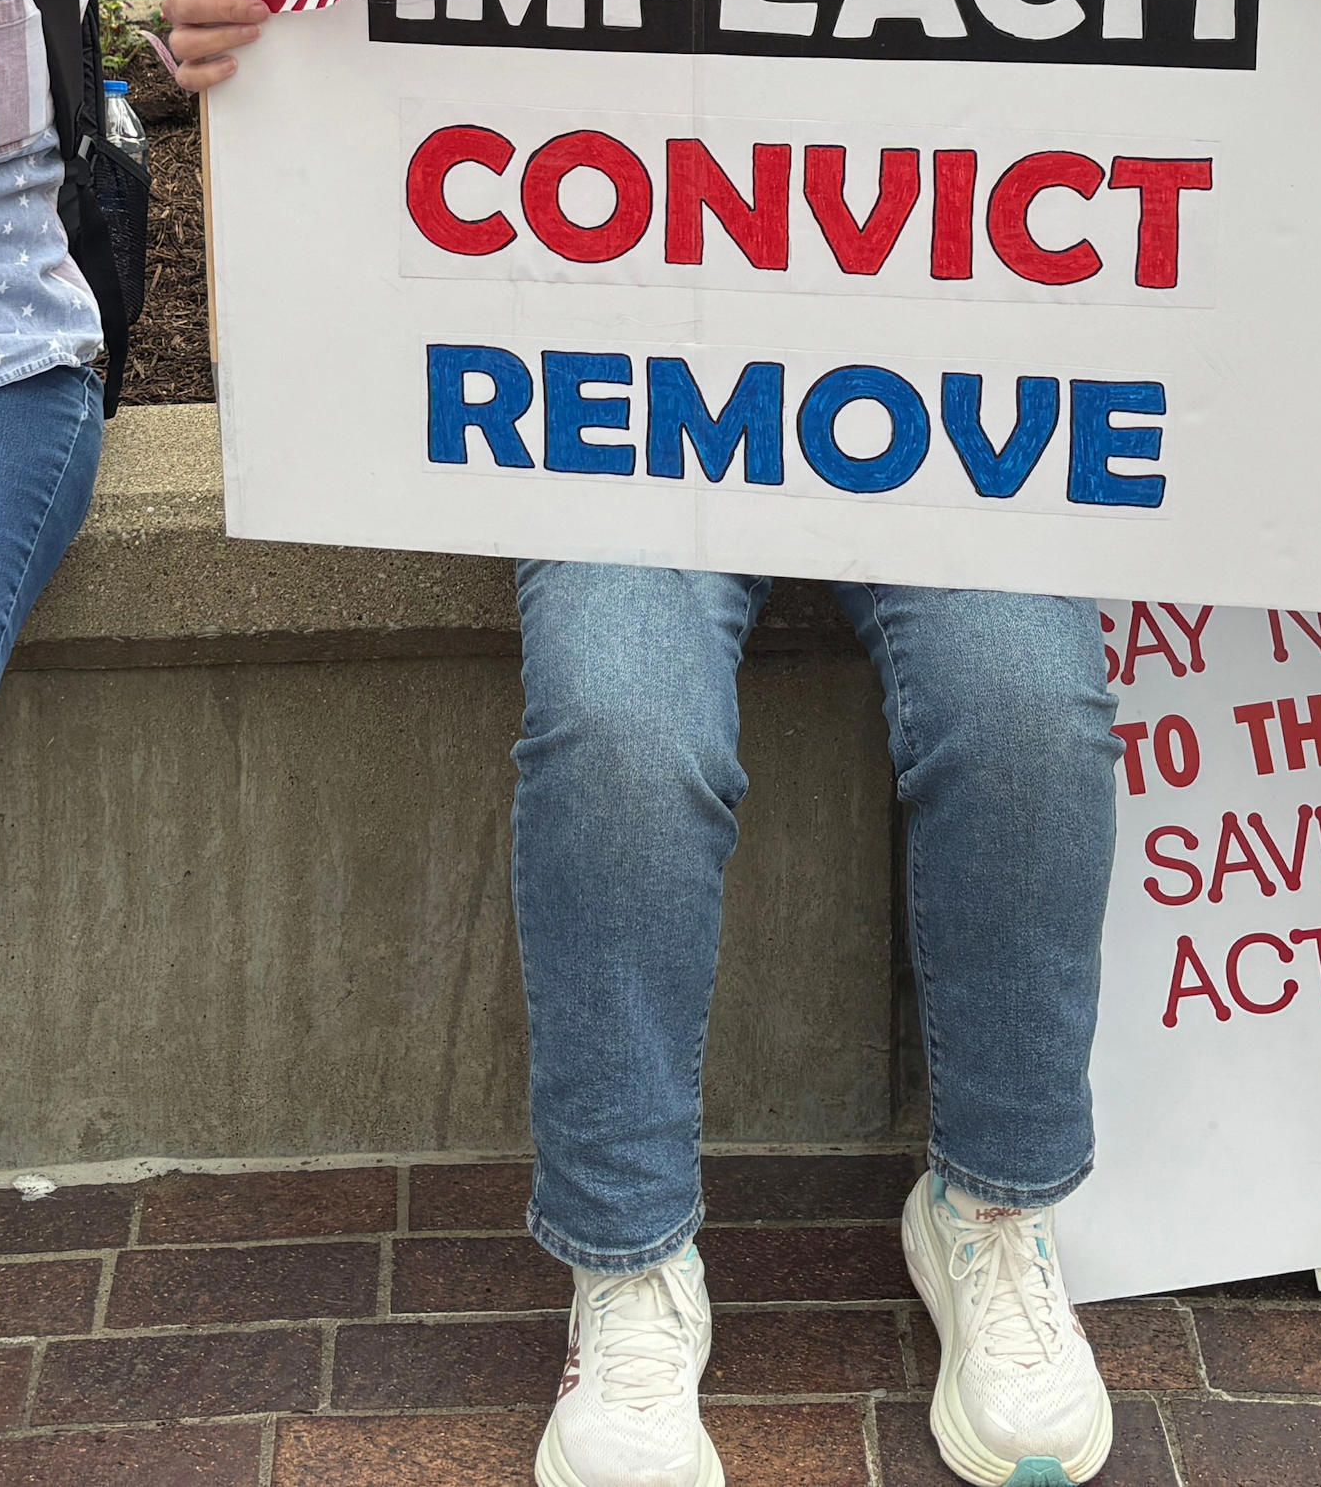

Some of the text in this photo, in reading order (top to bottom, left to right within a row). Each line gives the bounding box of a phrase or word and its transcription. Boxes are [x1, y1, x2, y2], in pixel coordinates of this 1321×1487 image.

[404, 124, 1214, 291] CONVICT
[426, 342, 1167, 509] REMOVE
[1110, 713, 1201, 796] TO
